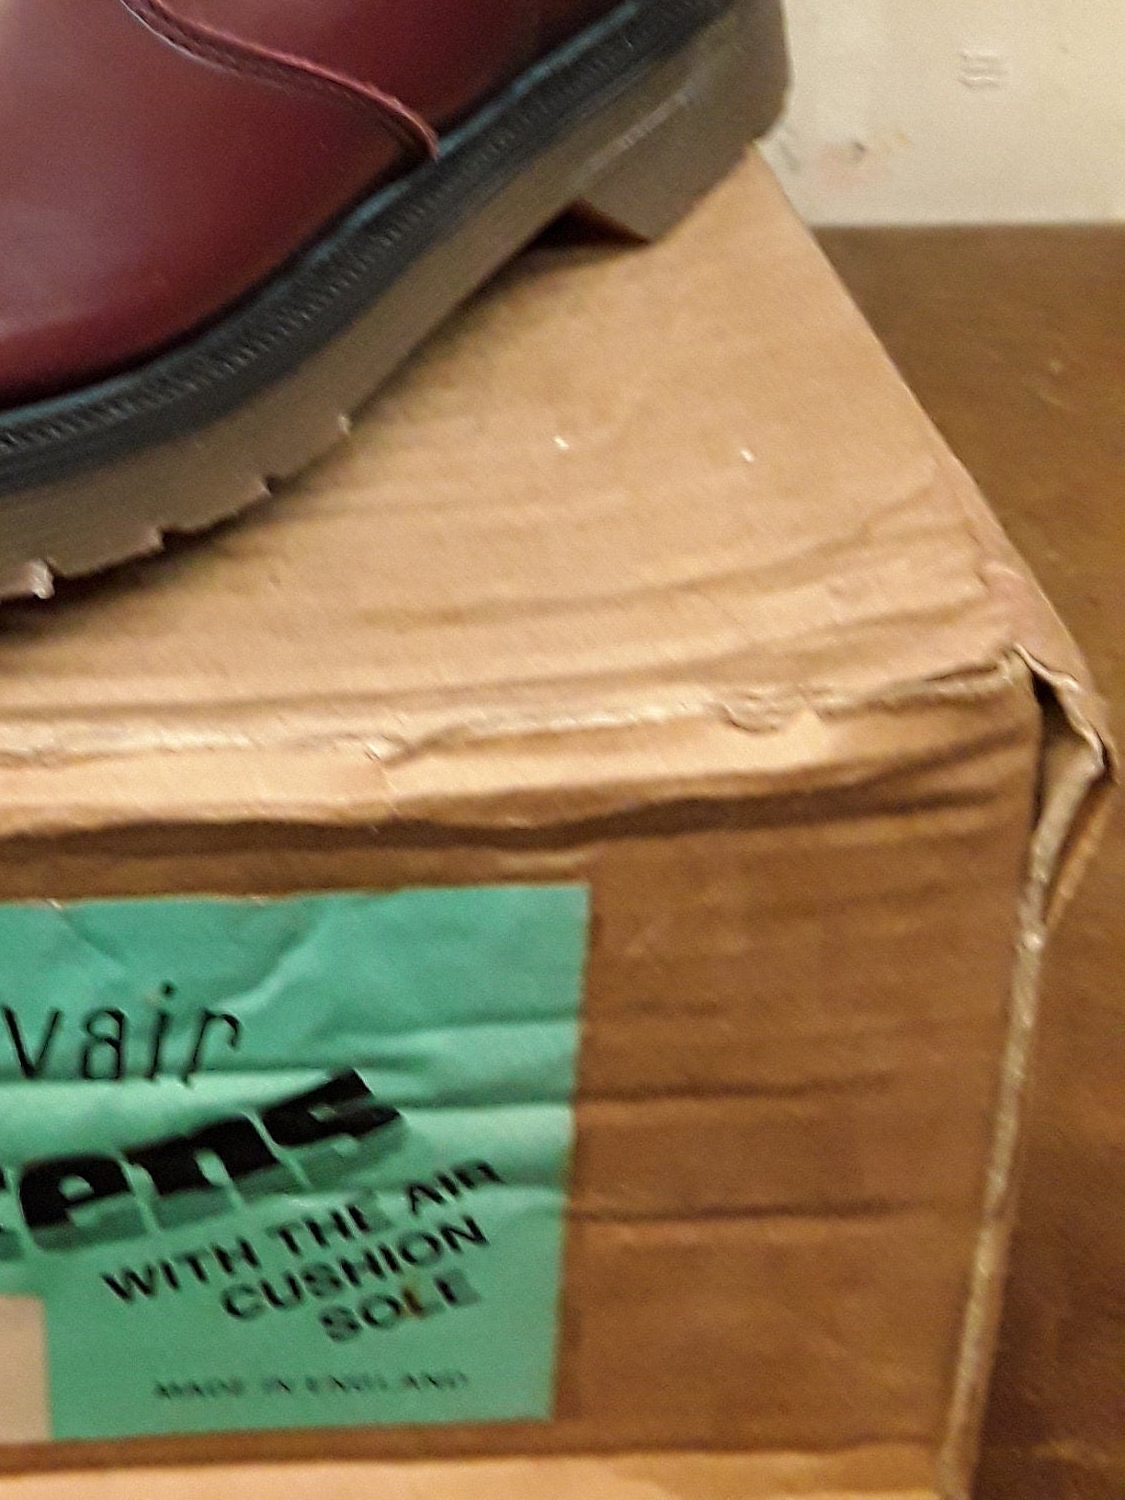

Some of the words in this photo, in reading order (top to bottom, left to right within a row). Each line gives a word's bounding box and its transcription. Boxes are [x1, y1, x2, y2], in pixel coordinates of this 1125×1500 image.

[101, 1237, 262, 1304] WITH
[271, 1202, 385, 1257] THE
[405, 1160, 503, 1216] AIR
[218, 1216, 489, 1323] CUSHION
[318, 1271, 479, 1344] SOLE
